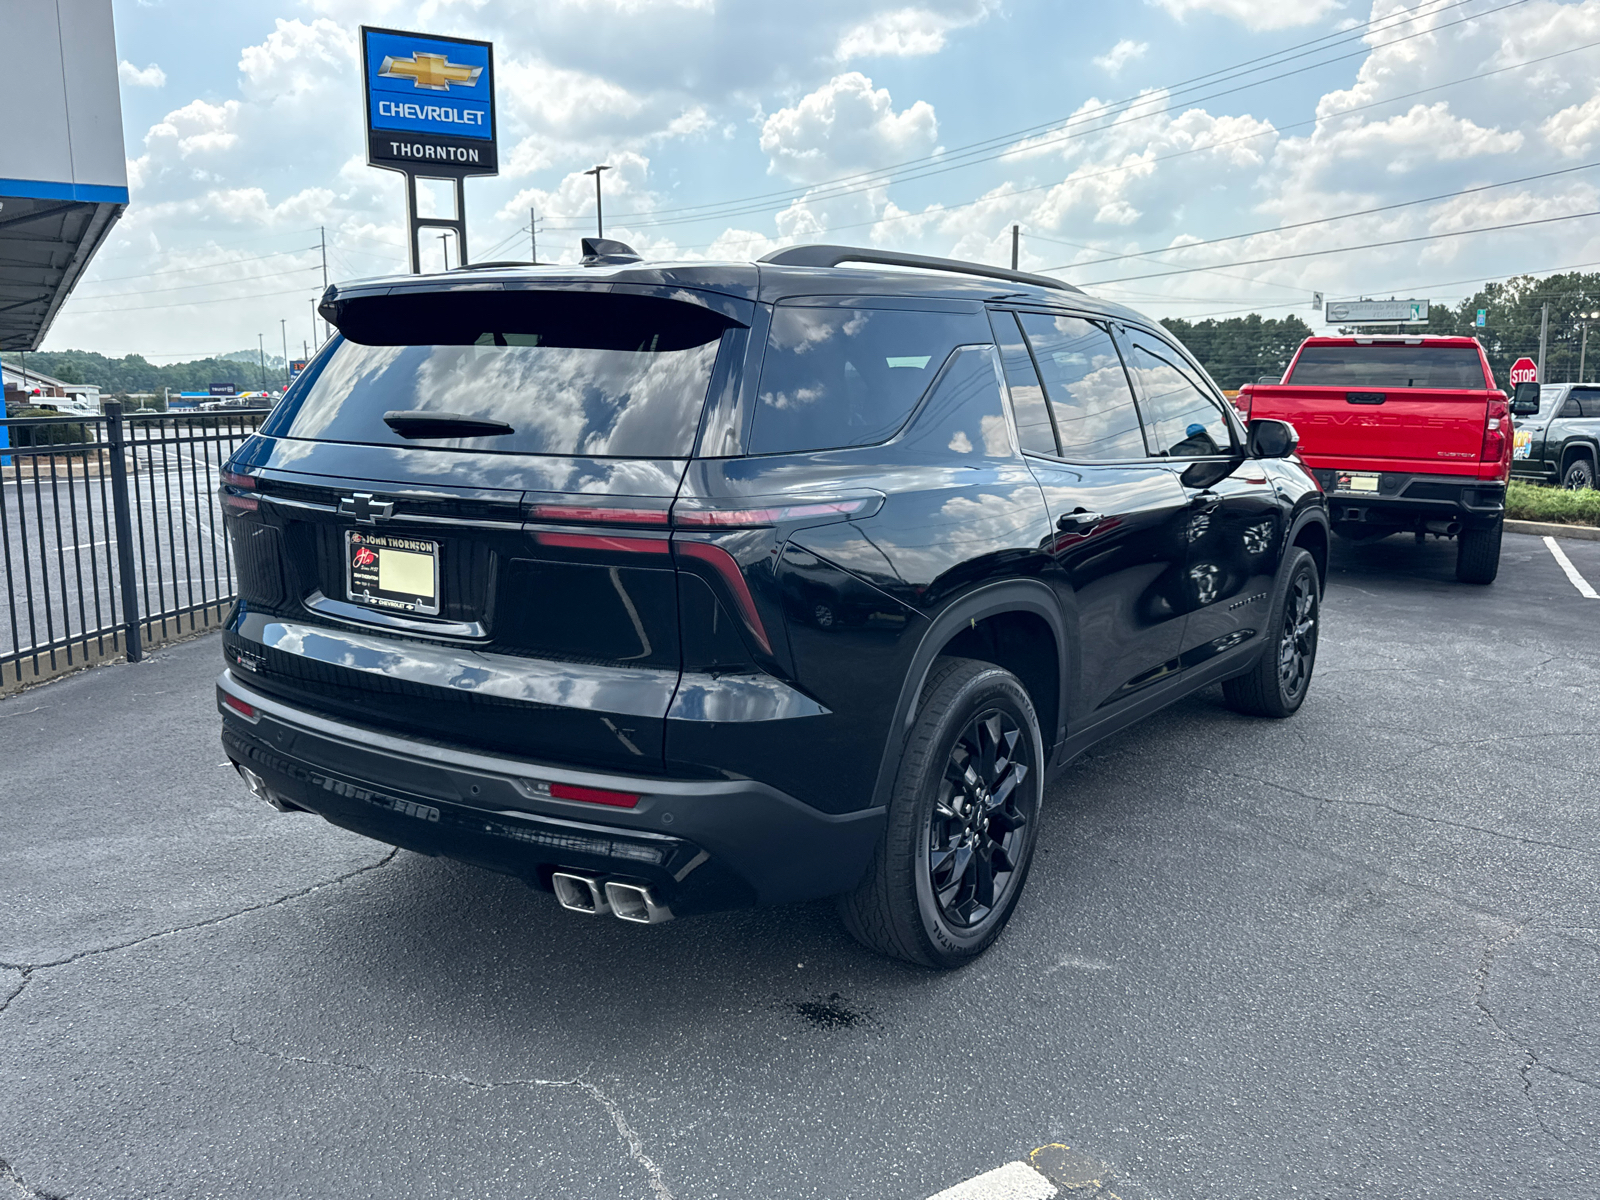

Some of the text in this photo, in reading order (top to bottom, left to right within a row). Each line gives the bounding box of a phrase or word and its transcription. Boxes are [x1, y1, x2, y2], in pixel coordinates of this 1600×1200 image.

[379, 101, 485, 125] CHEVROLET
[390, 142, 479, 162] THORNTON
[1350, 303, 1384, 311] CERTIFIED
[1386, 302, 1426, 310] PRE-OWD
[1512, 369, 1536, 383] STOP
[366, 535, 432, 552] JOHN THORNTON
[378, 600, 405, 609] CHEVROLET
